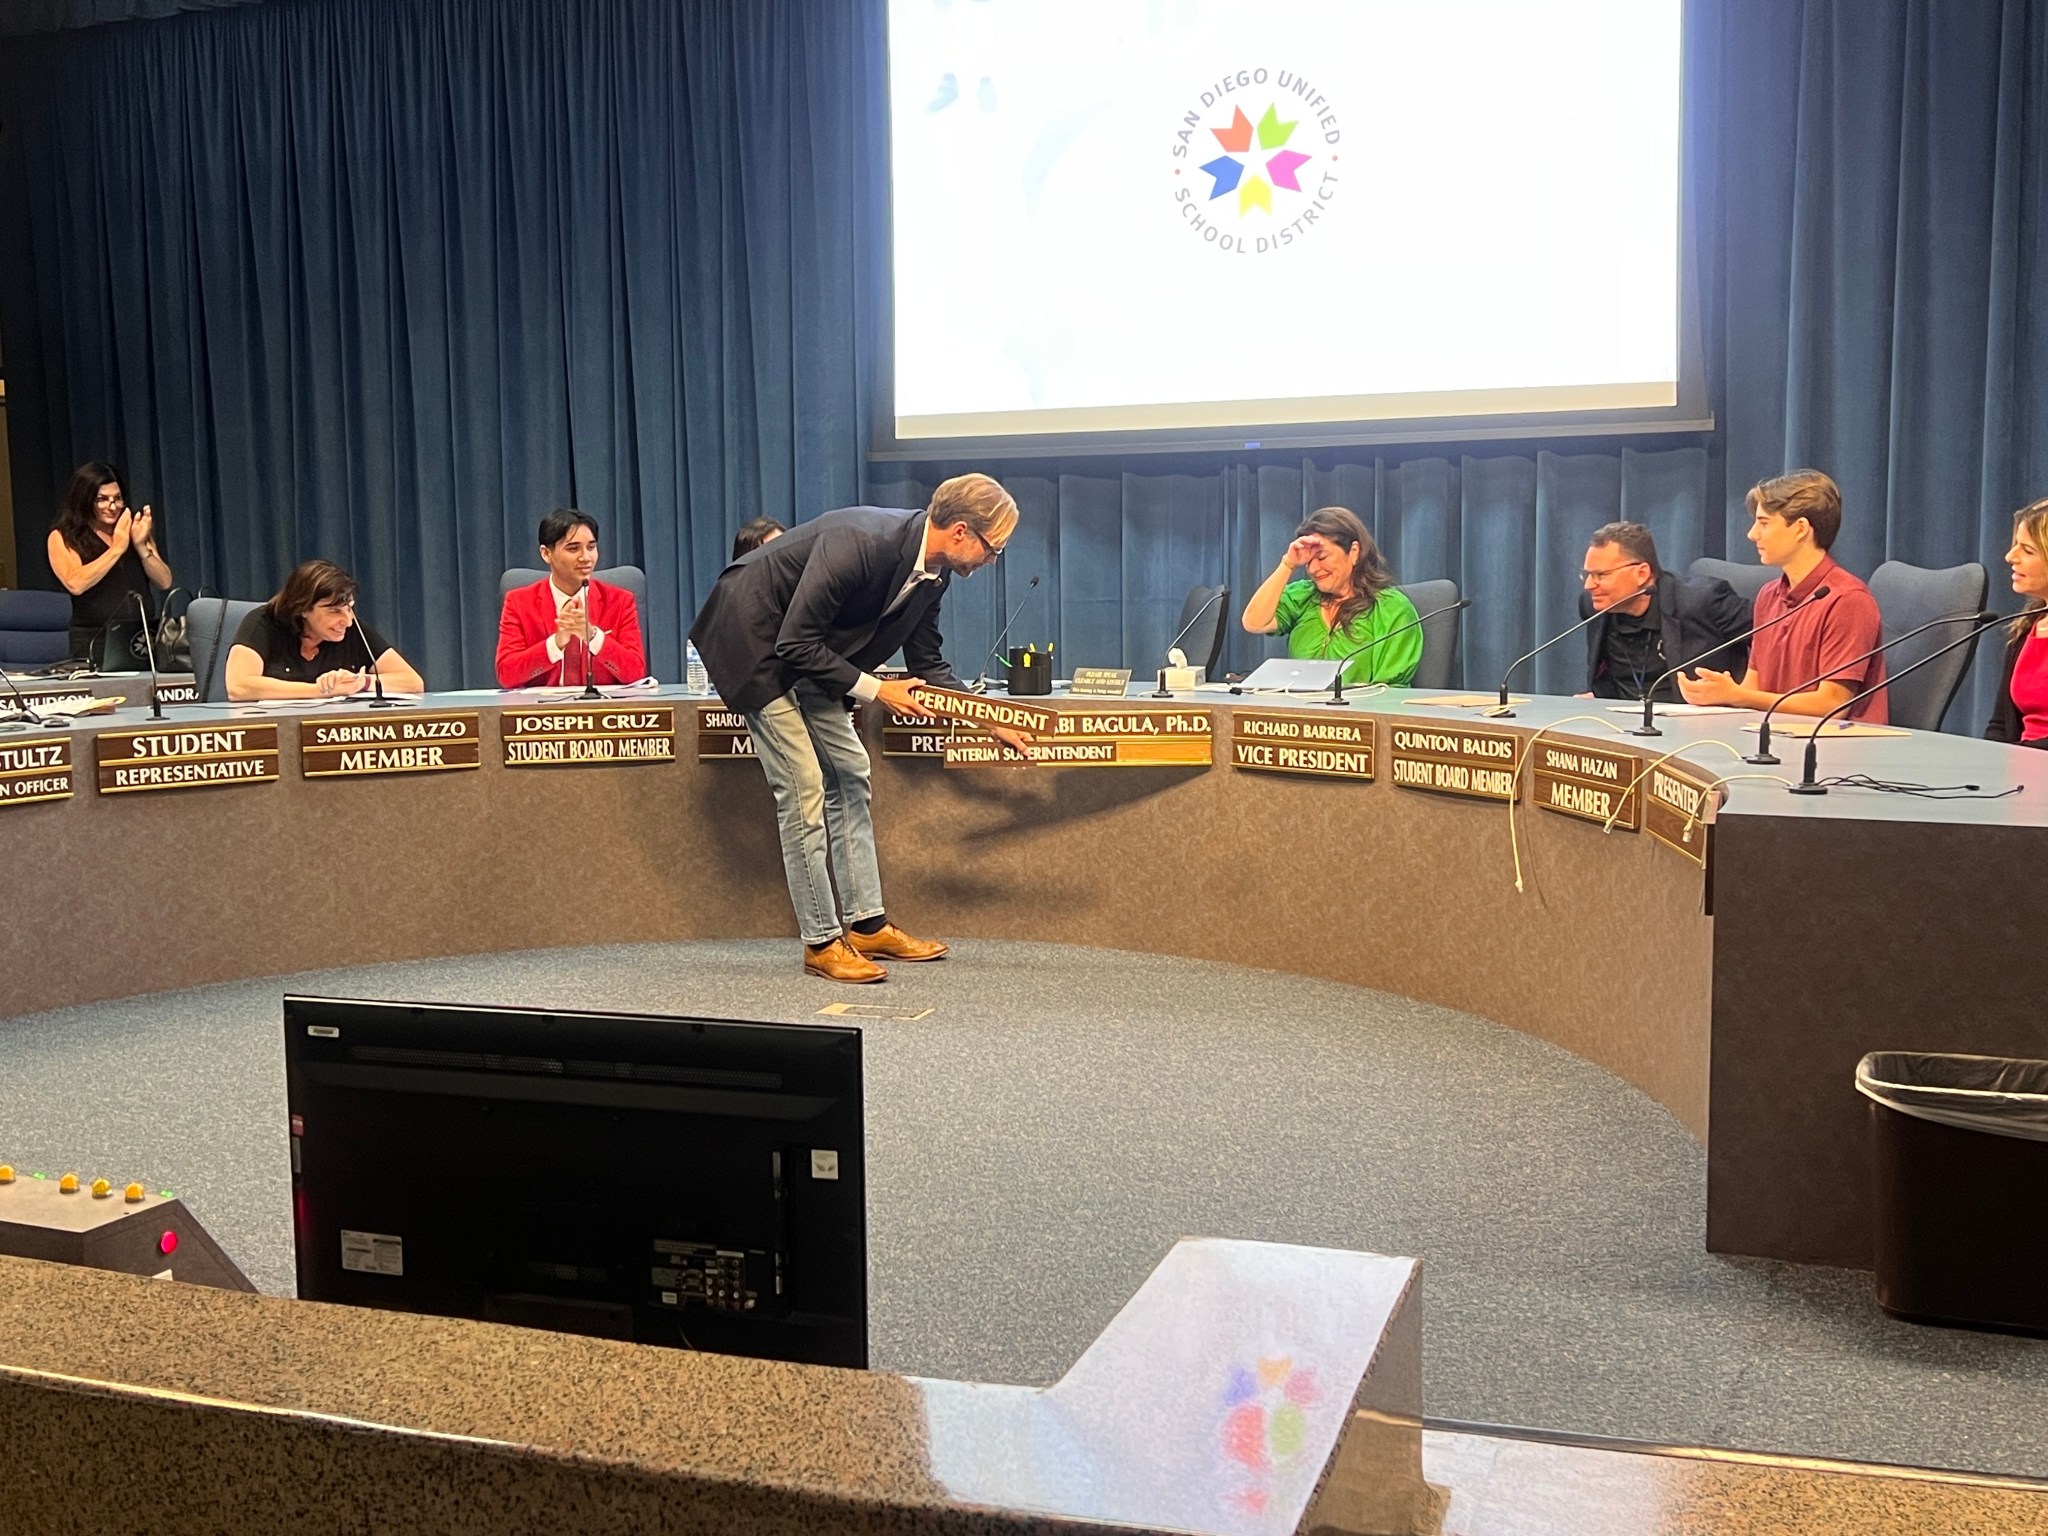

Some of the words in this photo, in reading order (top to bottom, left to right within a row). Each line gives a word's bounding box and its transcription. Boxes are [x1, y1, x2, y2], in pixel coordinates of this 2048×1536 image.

[1172, 110, 1200, 158] SAN
[1200, 68, 1268, 108] DIEGO
[1277, 70, 1340, 145] UNIFIED
[1175, 187, 1246, 254] SCHOOL
[1256, 170, 1338, 254] DISTRICT
[515, 715, 594, 734] JOSEPH
[602, 714, 660, 730] CRUZ
[911, 690, 1049, 731] PERINTENDENT
[316, 725, 396, 744] SABRINA
[403, 721, 466, 739] BAZZO
[1082, 716, 1160, 736] BAGULA,
[1166, 714, 1212, 732] Ph.D.
[1243, 720, 1300, 738] RICHARD
[1303, 724, 1362, 742] BARRERA
[132, 730, 246, 758] STUDENT
[508, 740, 565, 761] STUDENT
[570, 740, 614, 758] BOARD
[618, 738, 670, 757] MEMBER
[946, 748, 1000, 762] INTERIM
[1003, 746, 1114, 761] SUERINTENDENT
[1394, 731, 1458, 753] QUINTON
[1463, 738, 1512, 759] BALDIS
[0, 746, 64, 770] TULTZ
[340, 747, 444, 770] MEMBER
[1236, 745, 1274, 766] VICE
[1278, 748, 1368, 773] PRESIDENT
[1546, 750, 1579, 772] SHANA
[1581, 756, 1618, 780] HAZAN
[14, 776, 69, 796] OFFICER
[116, 760, 264, 786] REPRESENTATIVE
[1393, 759, 1434, 784] STUDENT
[1435, 765, 1468, 790] BOARD
[1470, 769, 1513, 796] MEMBER
[1550, 782, 1611, 818] MEMBER
[1653, 770, 1700, 818] PRESENTER
